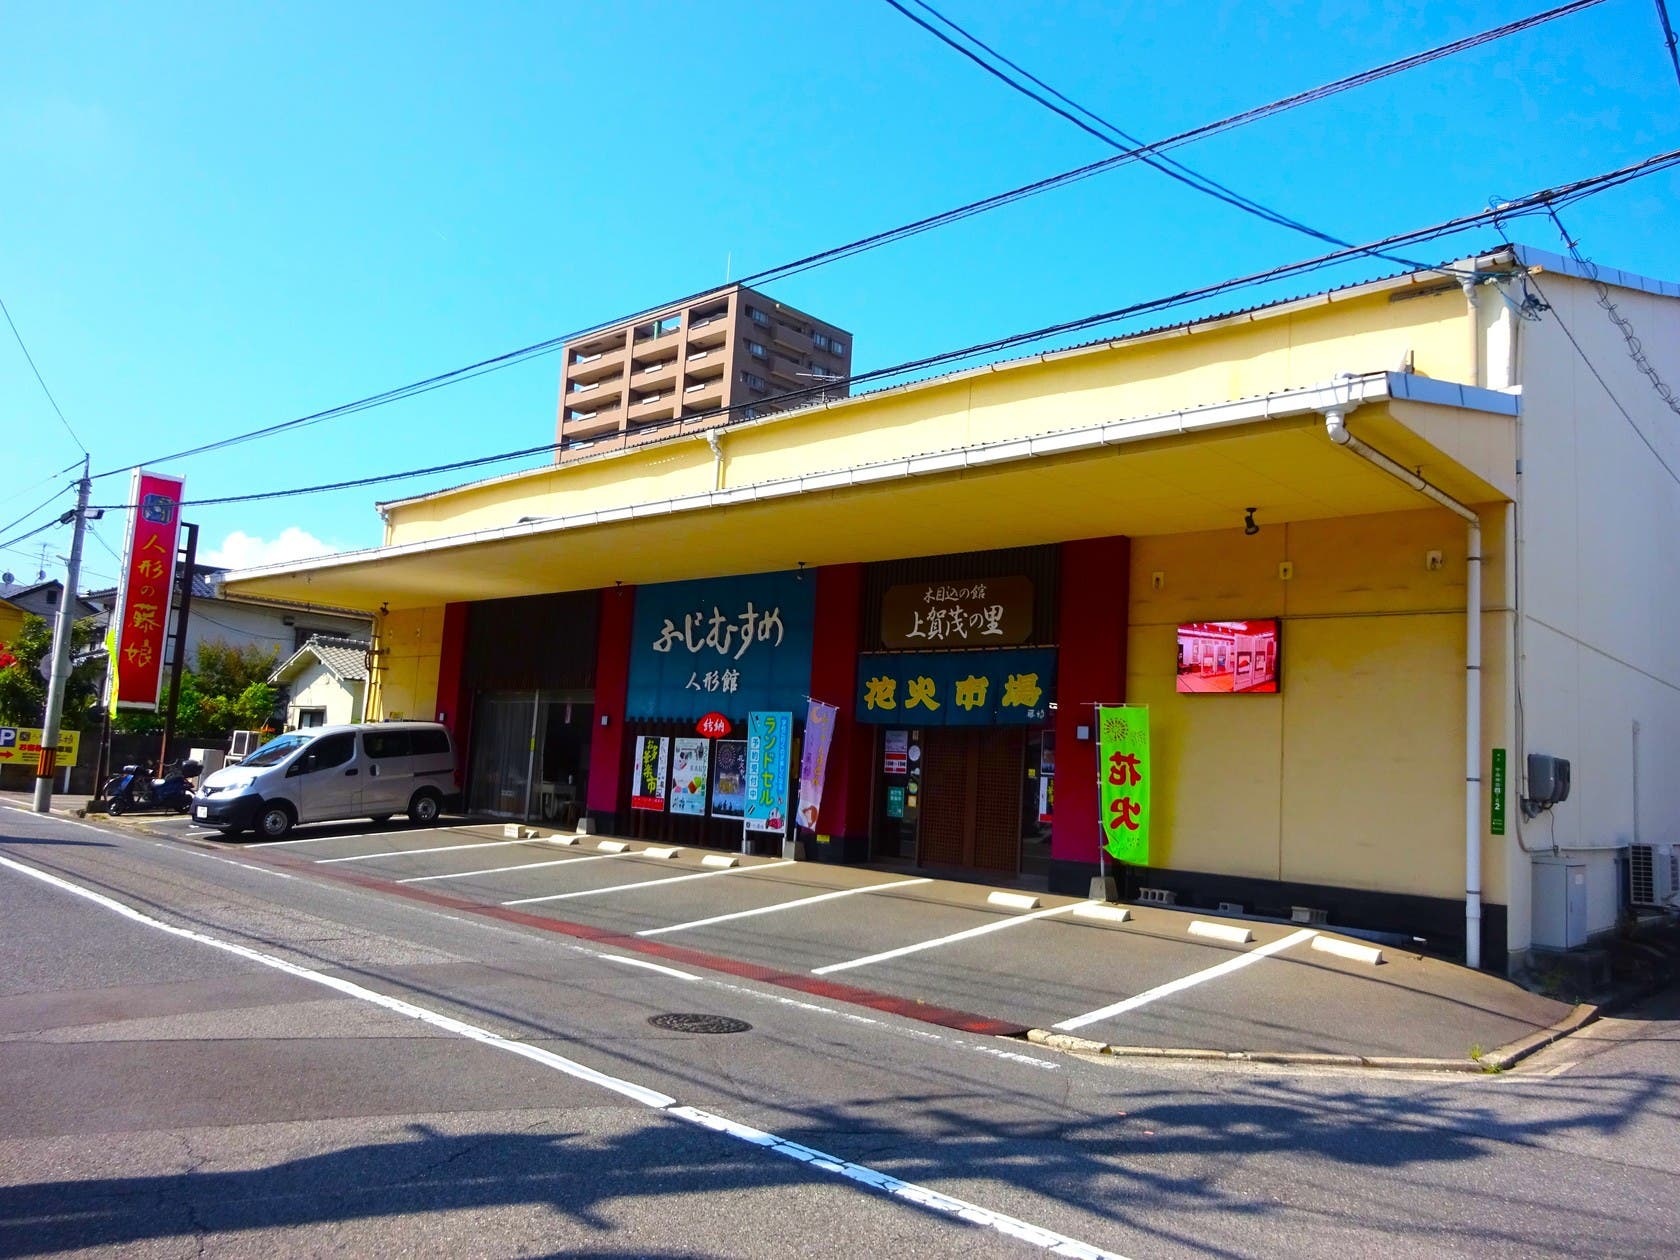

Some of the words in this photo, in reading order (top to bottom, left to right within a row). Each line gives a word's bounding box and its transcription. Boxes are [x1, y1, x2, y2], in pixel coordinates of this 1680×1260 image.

[124, 534, 166, 668] 人形の藤娘
[905, 604, 1004, 640] 上賀茂の里
[652, 601, 784, 660] ふじむすめ
[685, 668, 740, 694] 人形館
[864, 672, 1042, 711] 花火市場
[760, 717, 776, 806] ランドセル
